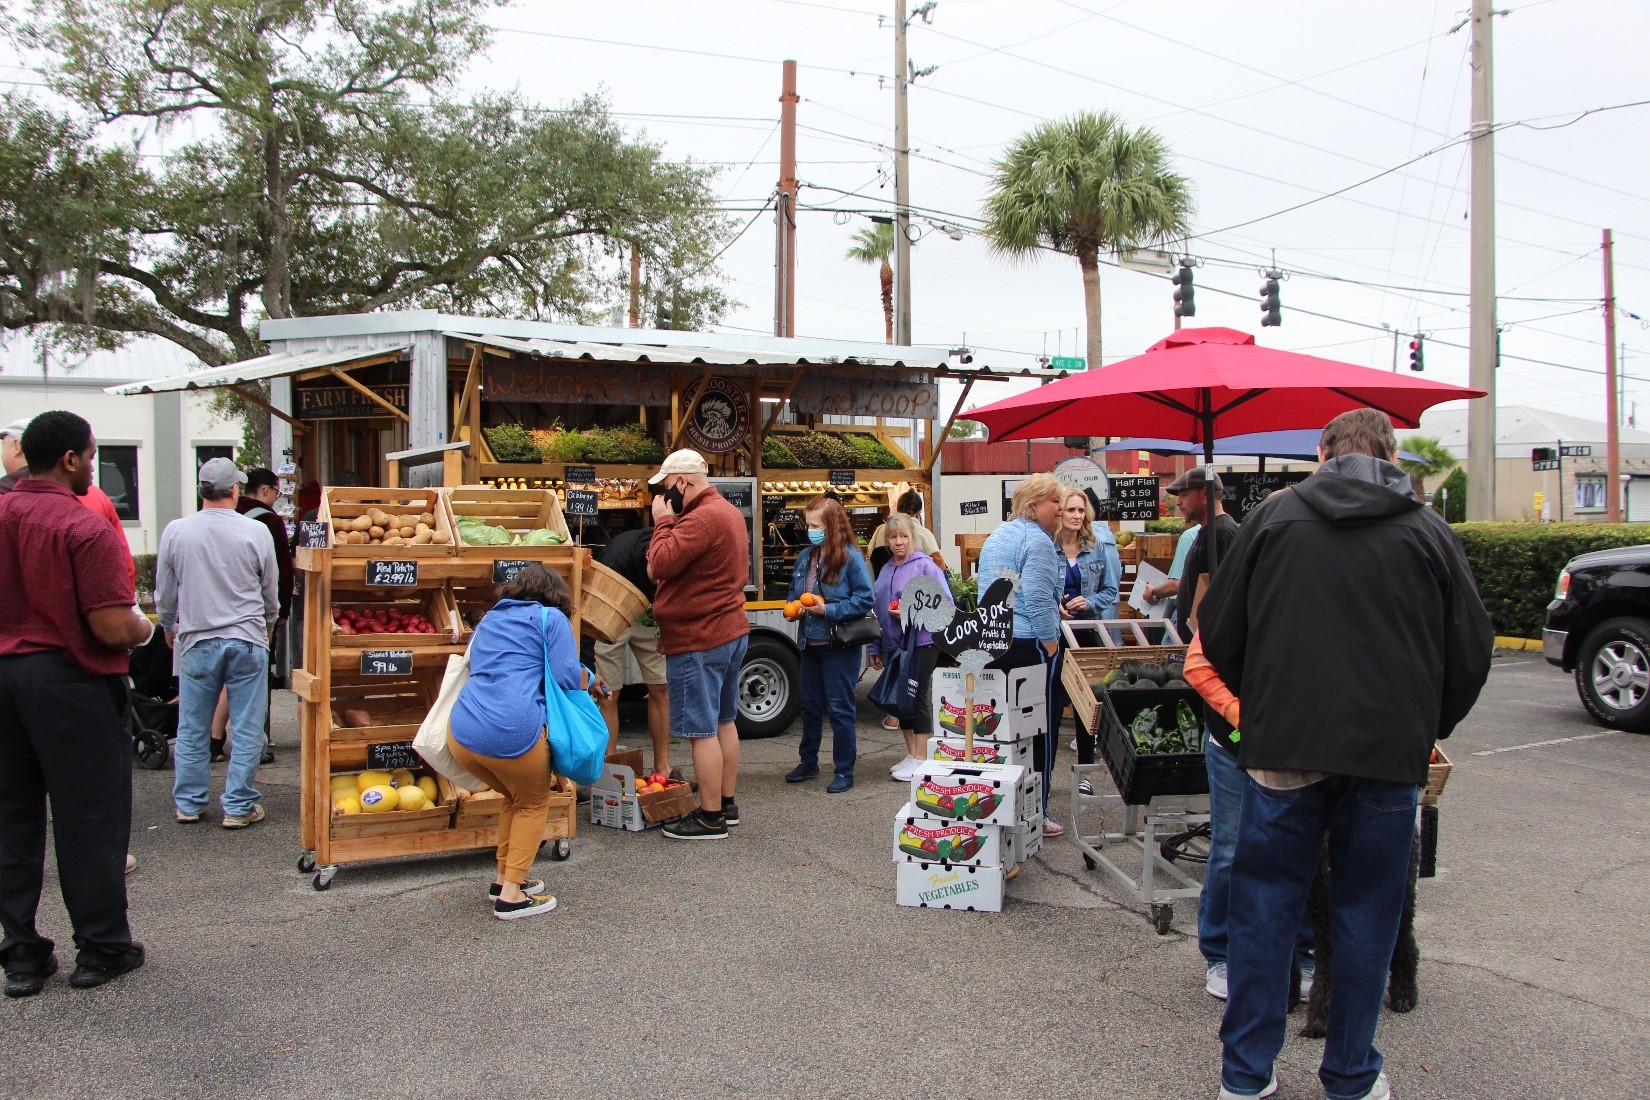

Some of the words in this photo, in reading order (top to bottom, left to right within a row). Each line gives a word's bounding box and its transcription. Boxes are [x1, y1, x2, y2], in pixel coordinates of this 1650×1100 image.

[302, 390, 346, 410] FARM
[712, 424, 746, 449] PRODUCE
[1115, 479, 1135, 487] Half
[1137, 478, 1156, 486] Flat
[1129, 489, 1151, 497] 3.59
[1117, 500, 1135, 508] Full
[1137, 500, 1156, 508] Flat
[1130, 511, 1152, 519] 7.00
[376, 562, 392, 573] Red
[913, 589, 942, 611] $20
[989, 620, 1011, 629] Mixed
[981, 629, 999, 638] Fruits
[978, 640, 1009, 652] Vegetables
[982, 673, 995, 681] COOL
[945, 703, 965, 715] FRESH
[941, 744, 964, 757] FRESH
[926, 781, 951, 795] FRESH
[951, 783, 990, 795] PRODUCE
[909, 825, 935, 838] FRESH
[936, 827, 974, 838] PRODUCE
[928, 870, 959, 887] Fresh
[918, 879, 980, 903] VEGETABLES
